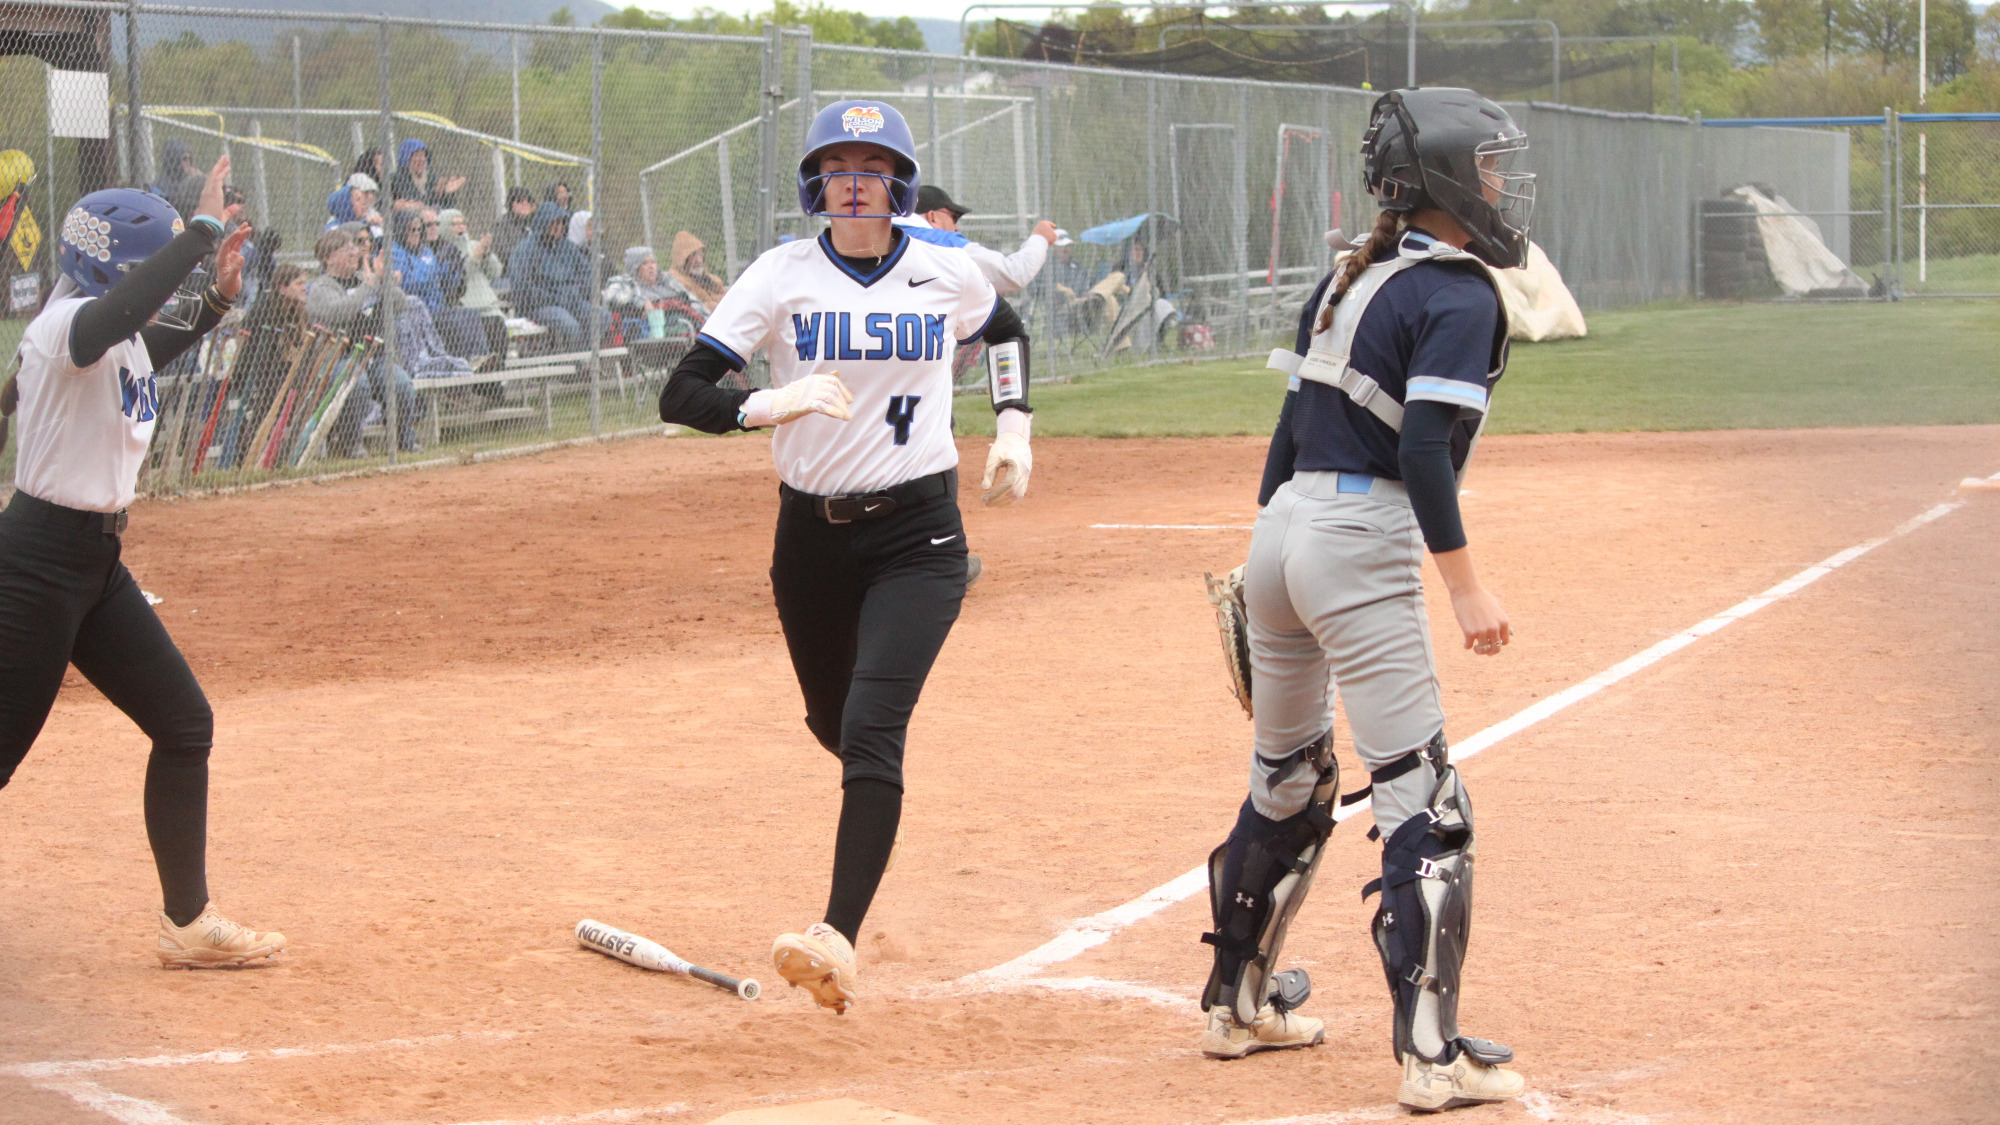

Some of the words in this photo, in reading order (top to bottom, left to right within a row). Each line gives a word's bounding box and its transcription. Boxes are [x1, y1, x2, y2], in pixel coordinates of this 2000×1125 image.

[843, 115, 882, 126] WILSON
[792, 312, 947, 361] WILSON
[885, 395, 921, 445] 4
[578, 924, 637, 957] EASTON
